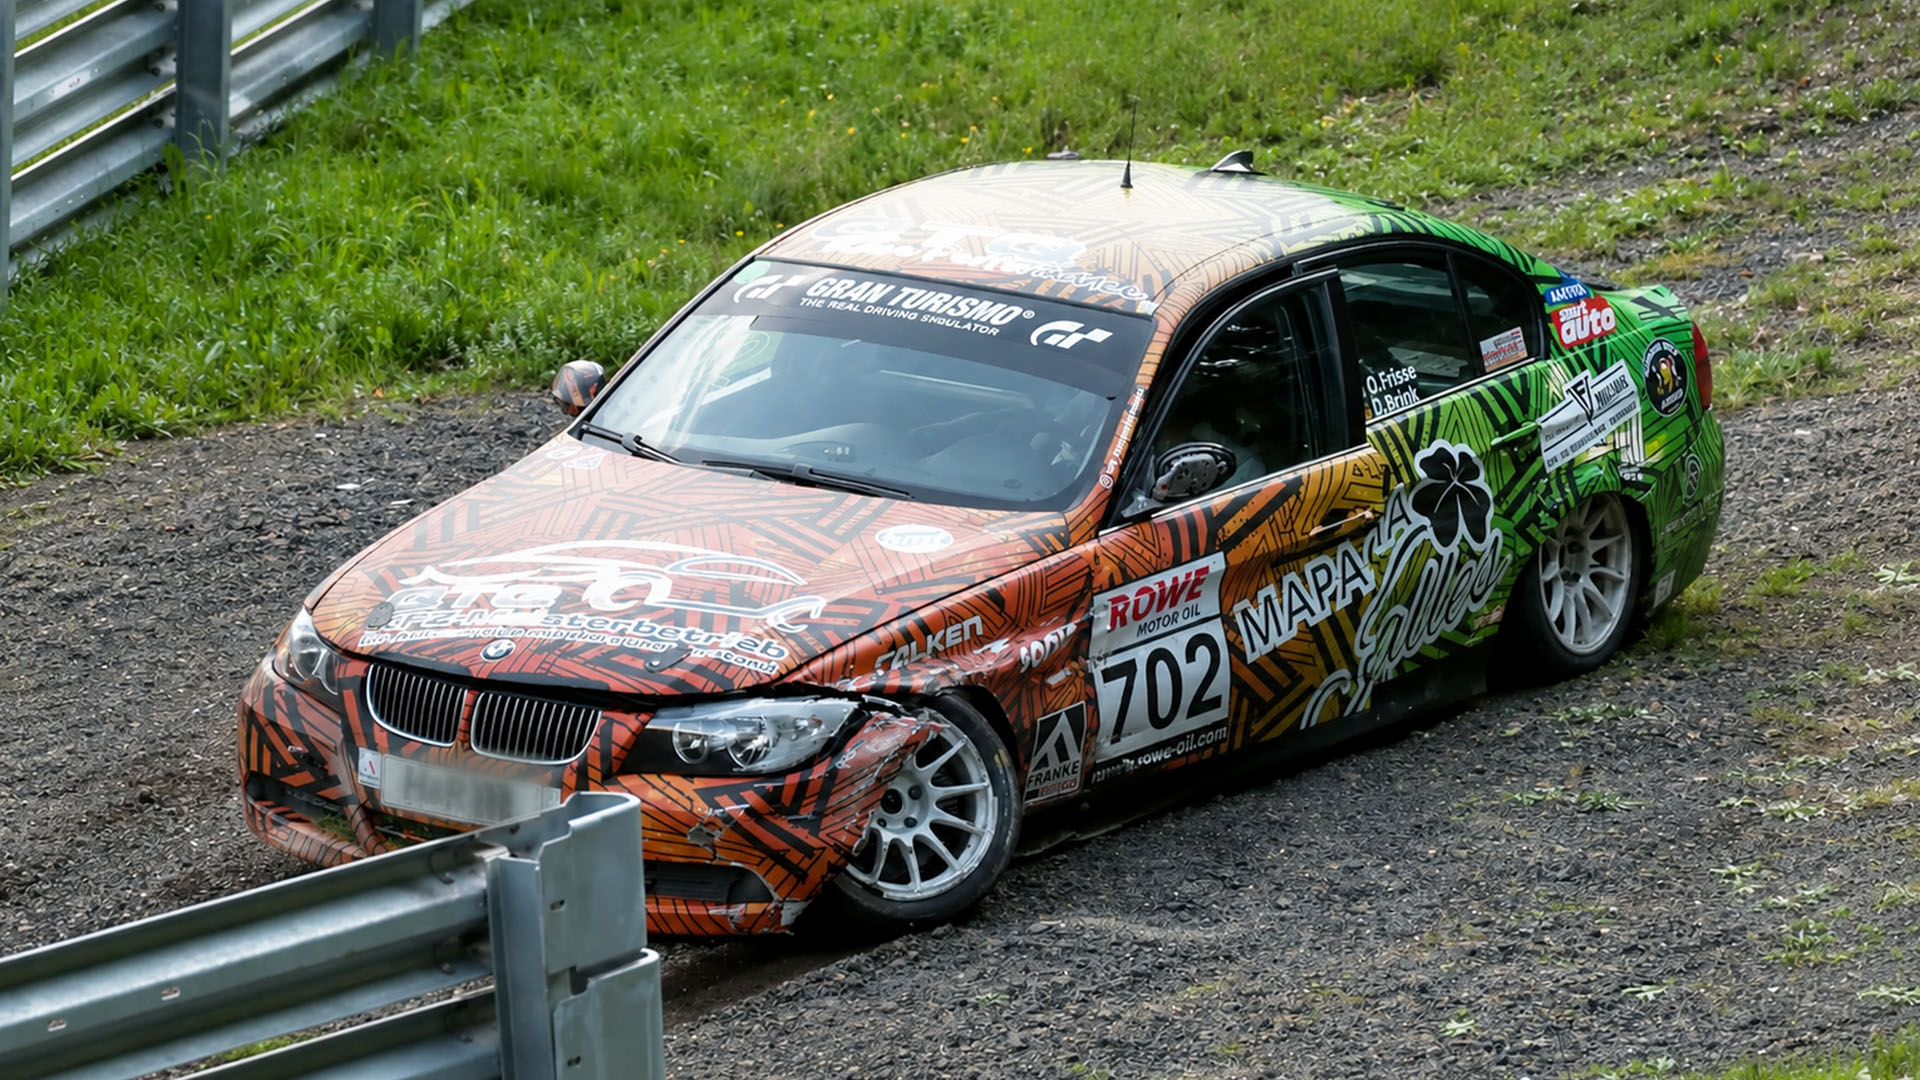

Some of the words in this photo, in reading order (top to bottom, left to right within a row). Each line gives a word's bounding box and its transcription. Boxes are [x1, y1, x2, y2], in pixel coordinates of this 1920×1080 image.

[806, 277, 895, 305] GRAN
[800, 297, 824, 308] THE
[827, 301, 860, 313] REAL
[864, 304, 918, 320] DRIVING
[1561, 307, 1616, 344] auto
[1366, 365, 1417, 394] O.Frisse
[1370, 385, 1420, 416] D.Brink
[1108, 565, 1210, 632] ROWE
[1136, 612, 1179, 638] MOTOR
[1182, 603, 1201, 623] OIL
[1100, 632, 1223, 745] 702
[1091, 726, 1228, 784] .rowe-oil.com
[1027, 760, 1080, 789] FRANKE
